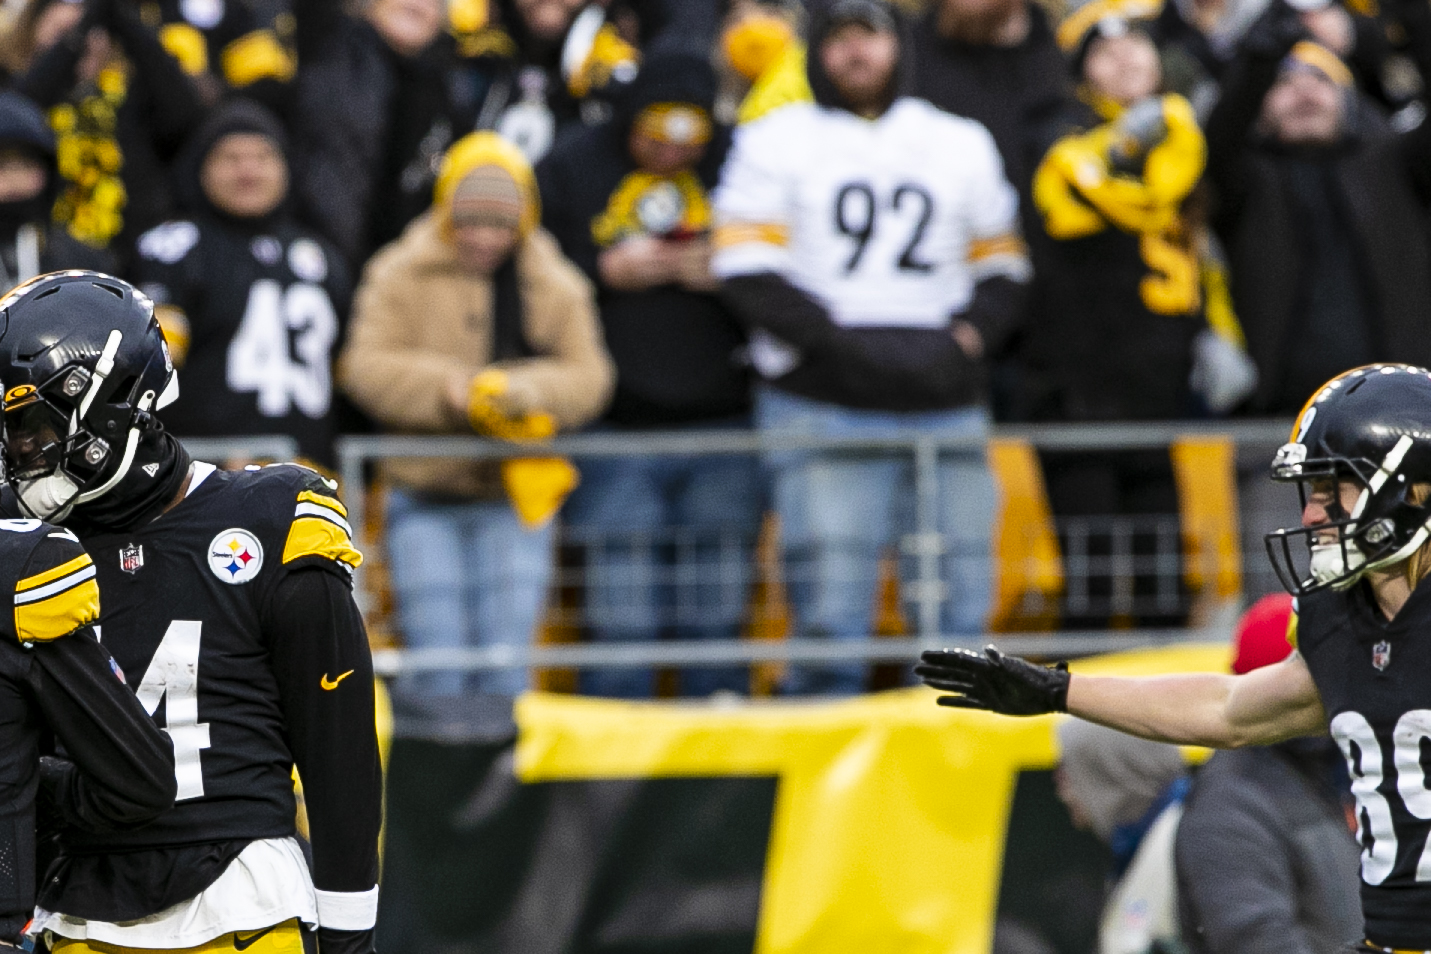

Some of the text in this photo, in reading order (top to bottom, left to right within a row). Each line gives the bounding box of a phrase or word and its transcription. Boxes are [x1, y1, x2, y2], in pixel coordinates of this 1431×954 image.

[834, 181, 936, 275] 92
[225, 278, 339, 418] 43
[93, 619, 211, 801] 4
